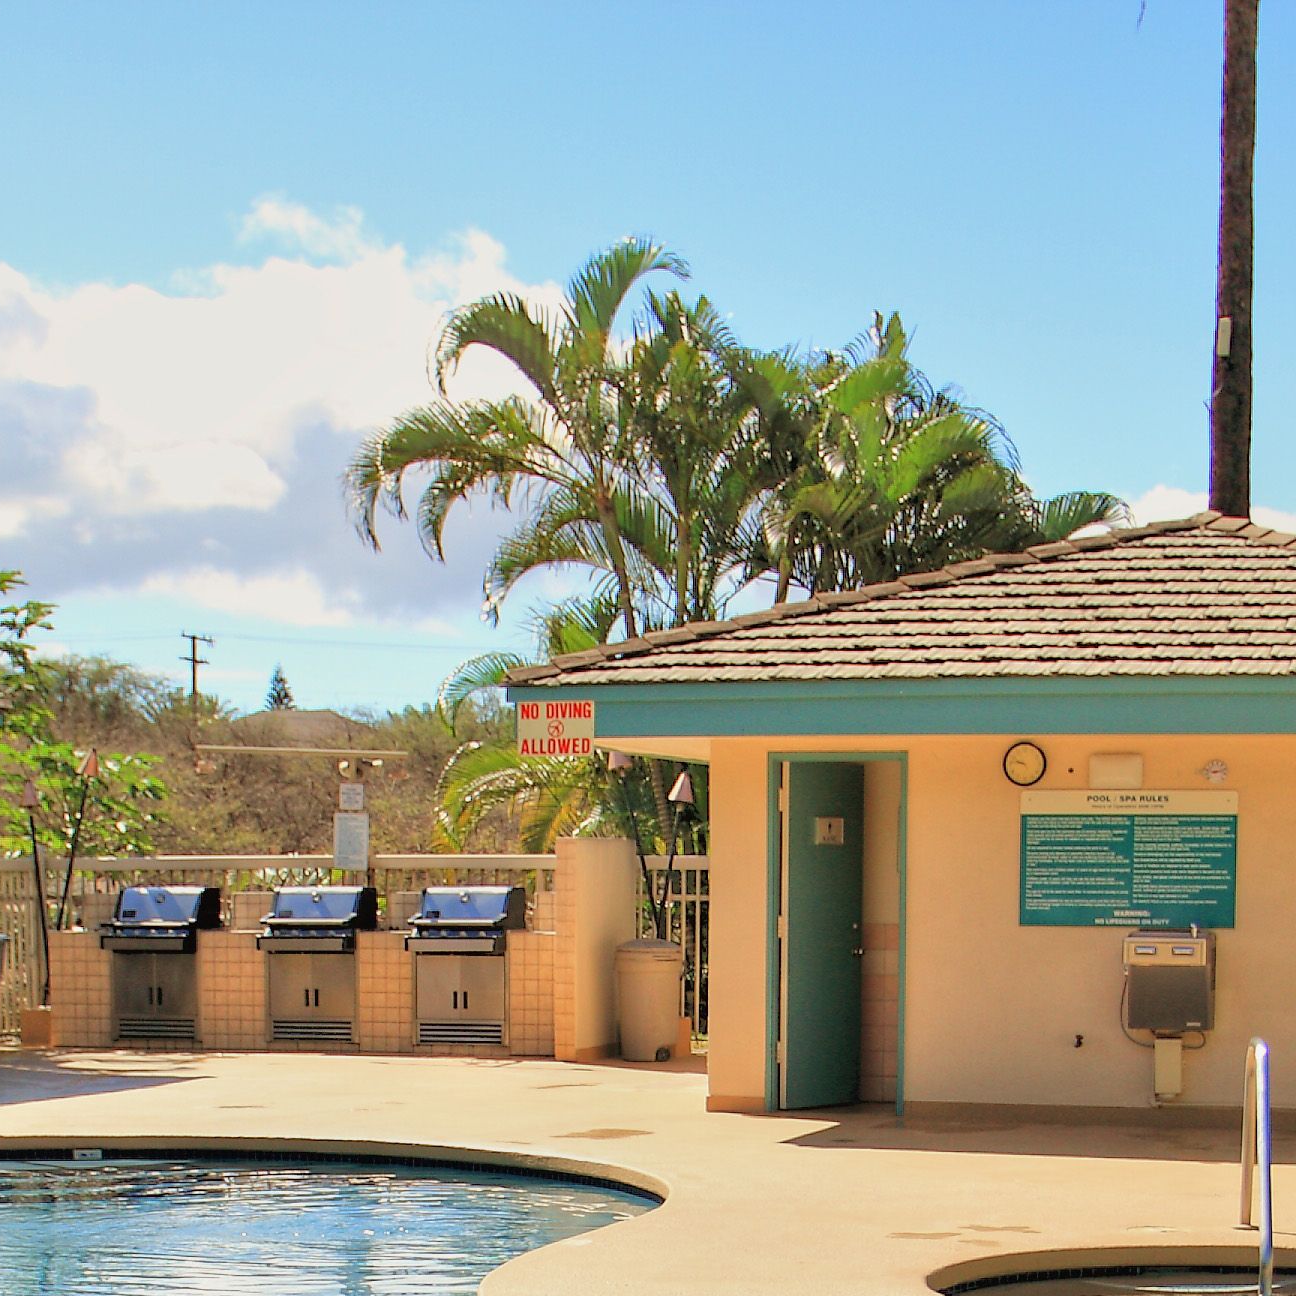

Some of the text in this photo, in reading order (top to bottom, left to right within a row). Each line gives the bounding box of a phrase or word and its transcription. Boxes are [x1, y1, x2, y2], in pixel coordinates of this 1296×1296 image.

[521, 702, 592, 720] NO DIVING
[521, 737, 591, 755] ALLOWED
